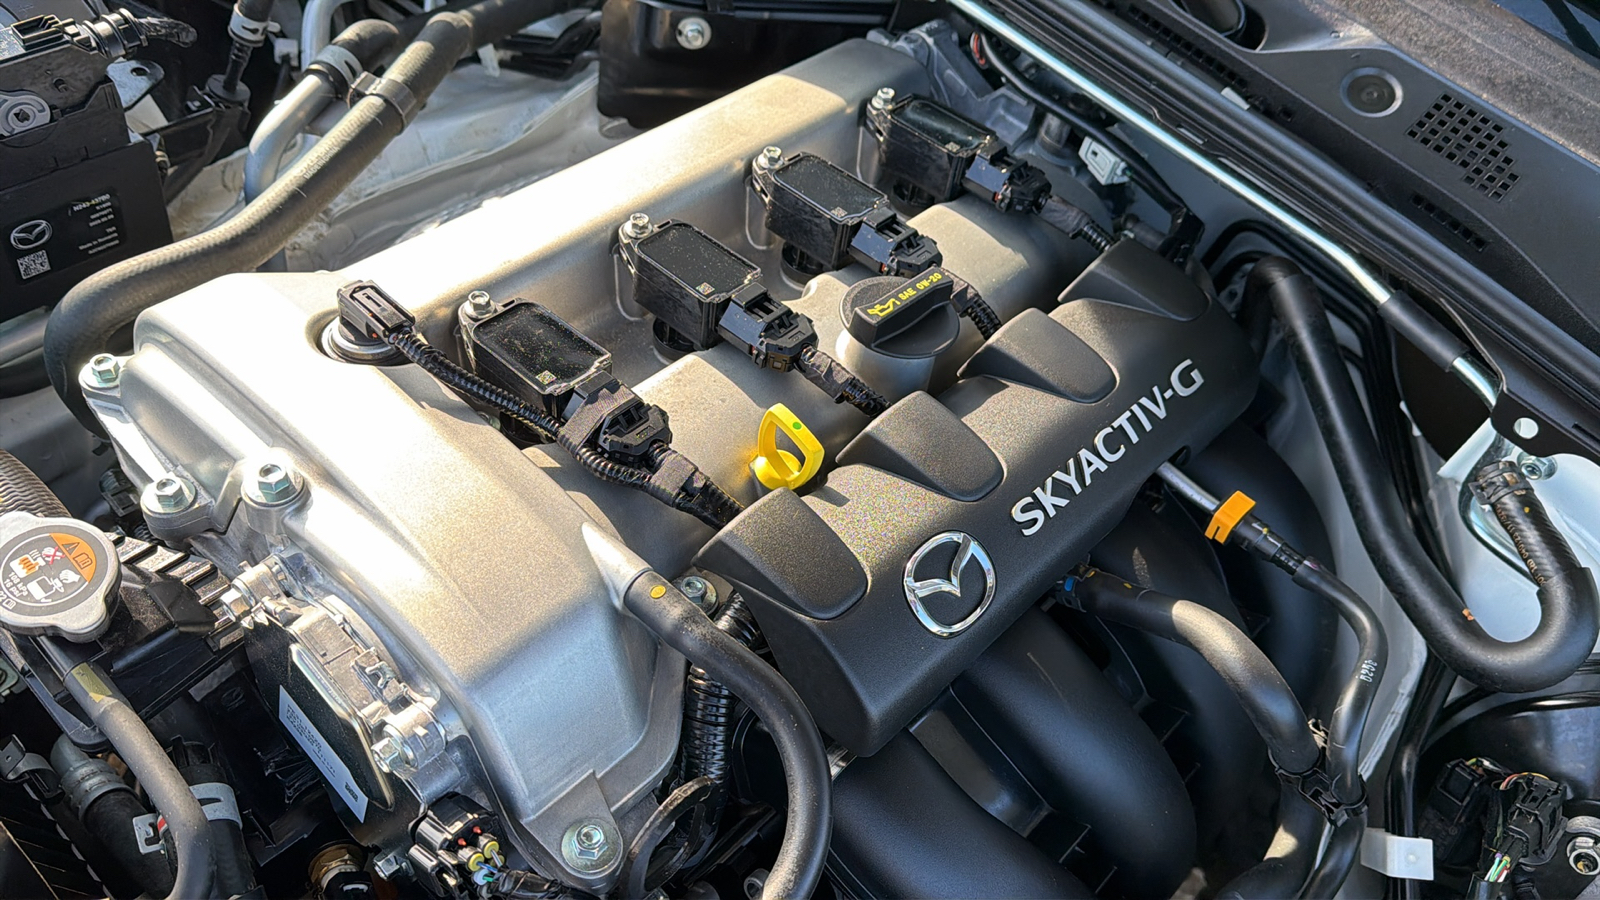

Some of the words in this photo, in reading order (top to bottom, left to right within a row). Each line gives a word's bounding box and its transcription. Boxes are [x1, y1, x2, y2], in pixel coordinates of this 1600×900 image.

[898, 287, 917, 300] SAE
[915, 272, 942, 290] 0W-20
[1011, 358, 1205, 537] SKYACTIV-G
[4, 579, 13, 588] 16
[9, 586, 23, 597] psi
[8, 572, 20, 584] 108
[17, 581, 28, 596] kPa
